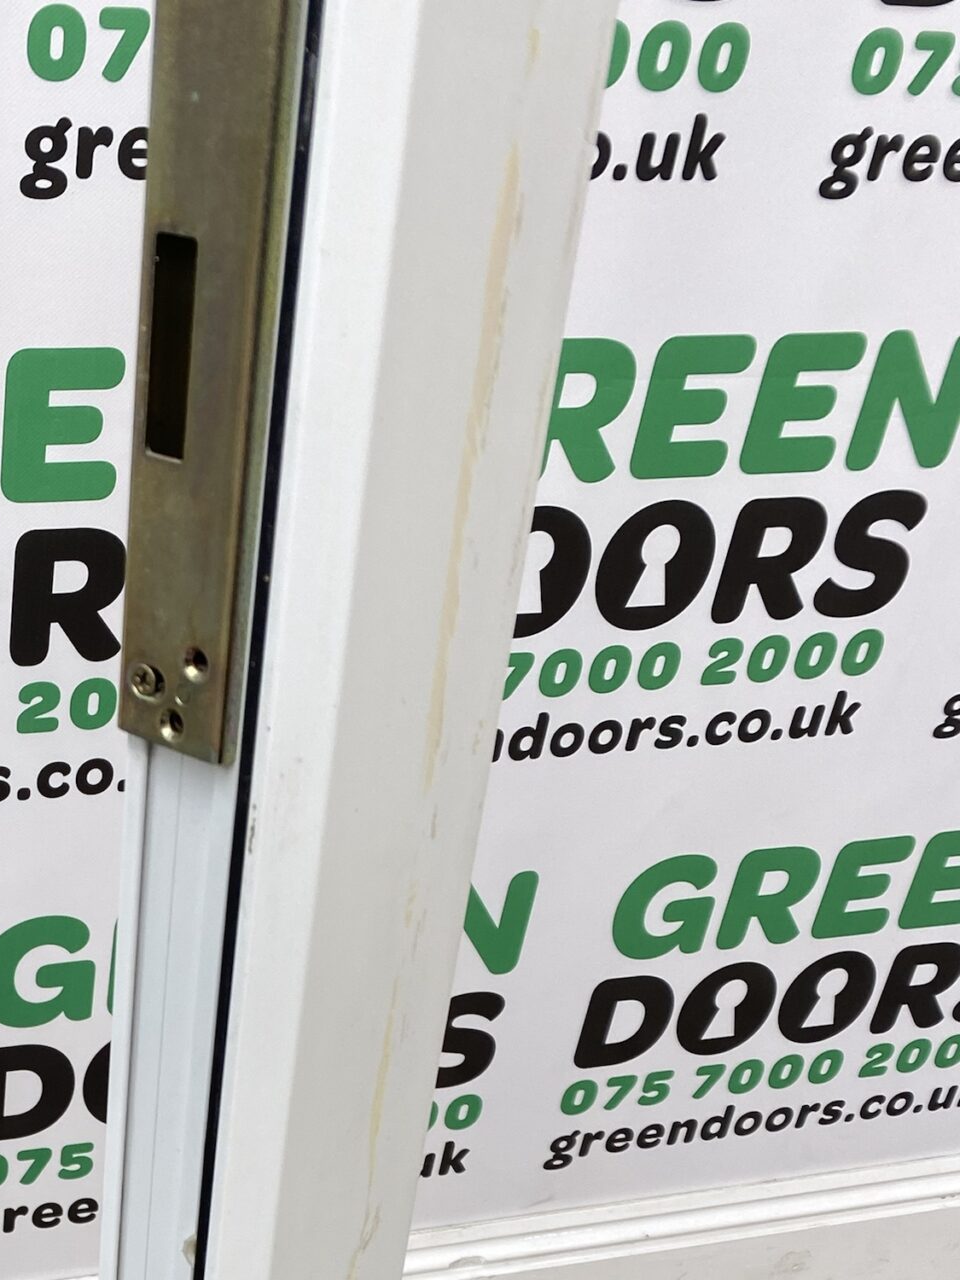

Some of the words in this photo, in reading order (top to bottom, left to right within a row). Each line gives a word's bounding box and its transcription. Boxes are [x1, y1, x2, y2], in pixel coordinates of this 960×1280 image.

[26, 3, 151, 83] 07
[851, 26, 960, 97] 07
[700, 629, 885, 685] 2000
[16, 676, 119, 735] 20
[573, 942, 960, 1069] DOOR
[427, 1093, 483, 1131] 0
[559, 1065, 675, 1116] 075
[692, 1051, 844, 1099] 7000
[542, 1085, 960, 1171] greendoors.co.u
